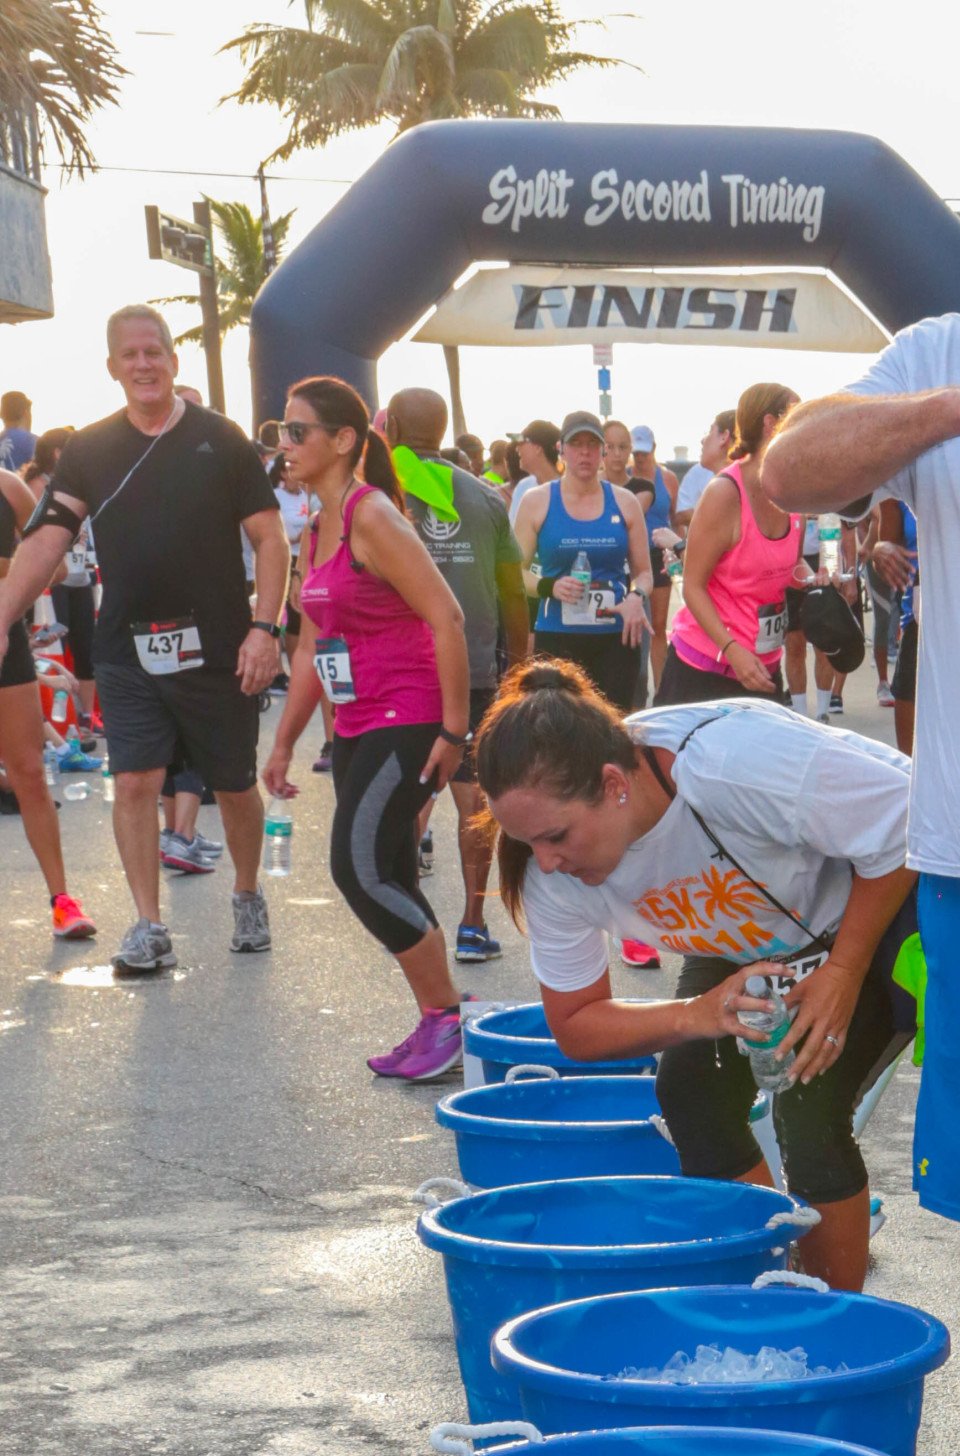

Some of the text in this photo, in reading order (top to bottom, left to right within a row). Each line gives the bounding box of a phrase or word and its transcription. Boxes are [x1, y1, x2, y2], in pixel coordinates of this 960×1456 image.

[482, 164, 825, 242] Split Second Timing
[512, 284, 798, 333] FINISH
[147, 632, 183, 655] 437
[645, 887, 711, 931] 5K
